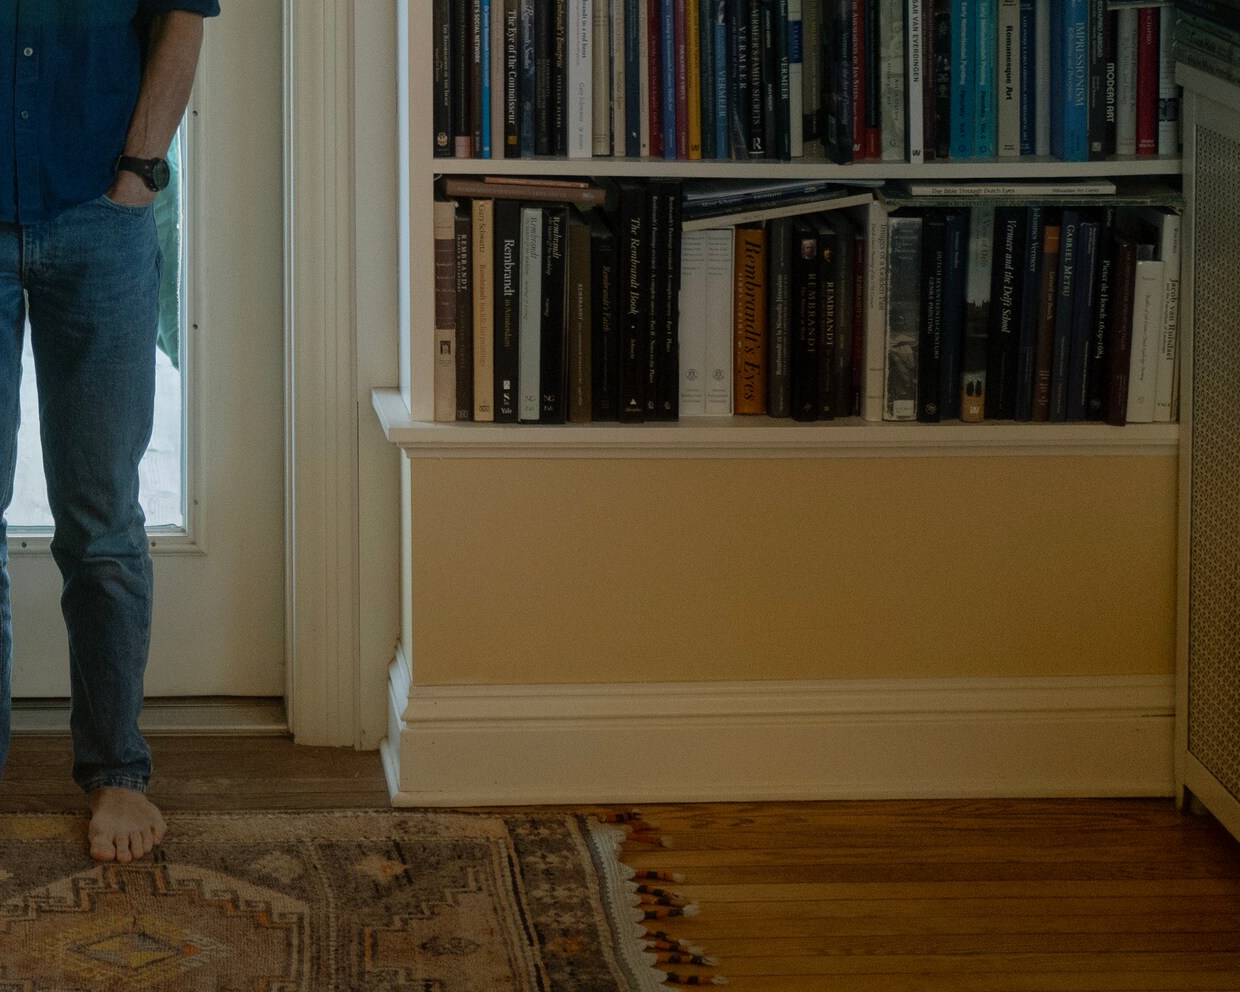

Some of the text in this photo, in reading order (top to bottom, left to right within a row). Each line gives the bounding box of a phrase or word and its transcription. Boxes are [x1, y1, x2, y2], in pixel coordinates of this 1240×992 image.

[506, 28, 517, 43] Eye
[508, 44, 517, 53] of
[508, 55, 517, 69] the
[912, 34, 920, 83] EVERDINGEN
[1004, 25, 1013, 84] Romanesque
[780, 56, 788, 100] VERMEER
[1075, 22, 1085, 106] IMPRESSIONISM
[507, 71, 517, 124] Connoisseur
[1106, 63, 1115, 122] MODERN ART
[503, 239, 515, 296] Rembrandt
[630, 238, 640, 289] Rembrandt
[1000, 220, 1017, 334] Vermeer and the Delft School
[1062, 224, 1075, 297] GABRIEL METSU
[627, 292, 639, 315] Book
[743, 240, 762, 401] Rembrandt's Eyes
